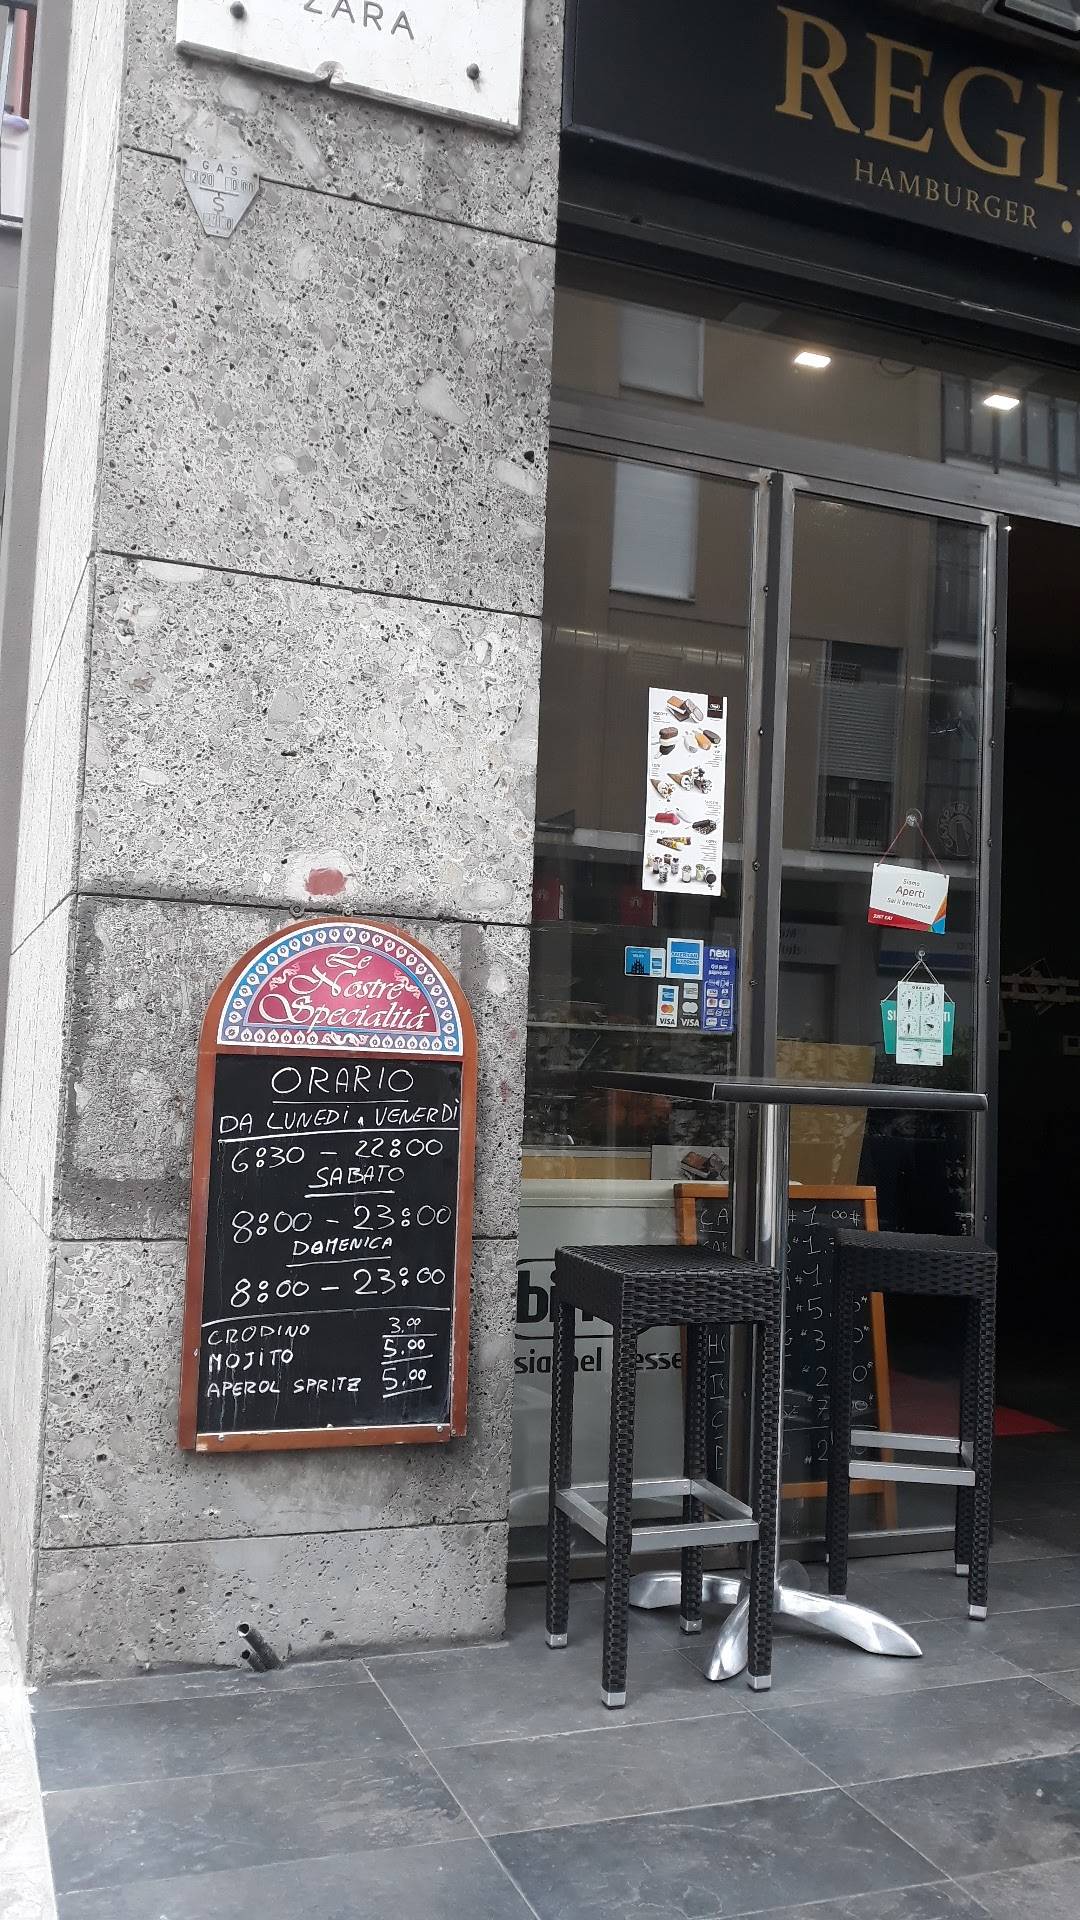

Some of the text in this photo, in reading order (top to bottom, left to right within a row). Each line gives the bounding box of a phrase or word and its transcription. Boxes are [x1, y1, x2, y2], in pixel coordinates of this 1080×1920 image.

[775, 6, 1080, 192] REGI
[202, 160, 238, 176] GAS
[855, 158, 1037, 229] HAMBURGER
[896, 886, 926, 898] Aperti
[325, 944, 373, 970] Le
[709, 948, 730, 958] nexi
[288, 964, 402, 1001] Nostre
[659, 1017, 676, 1026] VISA
[680, 1018, 700, 1027] VISA
[271, 1065, 414, 1094] ORARIO
[219, 1113, 253, 1135] DA
[231, 1146, 305, 1173] 6:30
[355, 1137, 444, 1158] 22:00
[308, 1165, 405, 1188] SABATO
[231, 1210, 312, 1244] 8:00
[352, 1204, 452, 1231] 23:00
[292, 1237, 393, 1256] DOMENICA
[230, 1278, 310, 1308] 8:00
[353, 1267, 446, 1296] 23:00
[207, 1324, 310, 1346] CRODINO
[207, 1376, 362, 1398] APEROL SPRITZ
